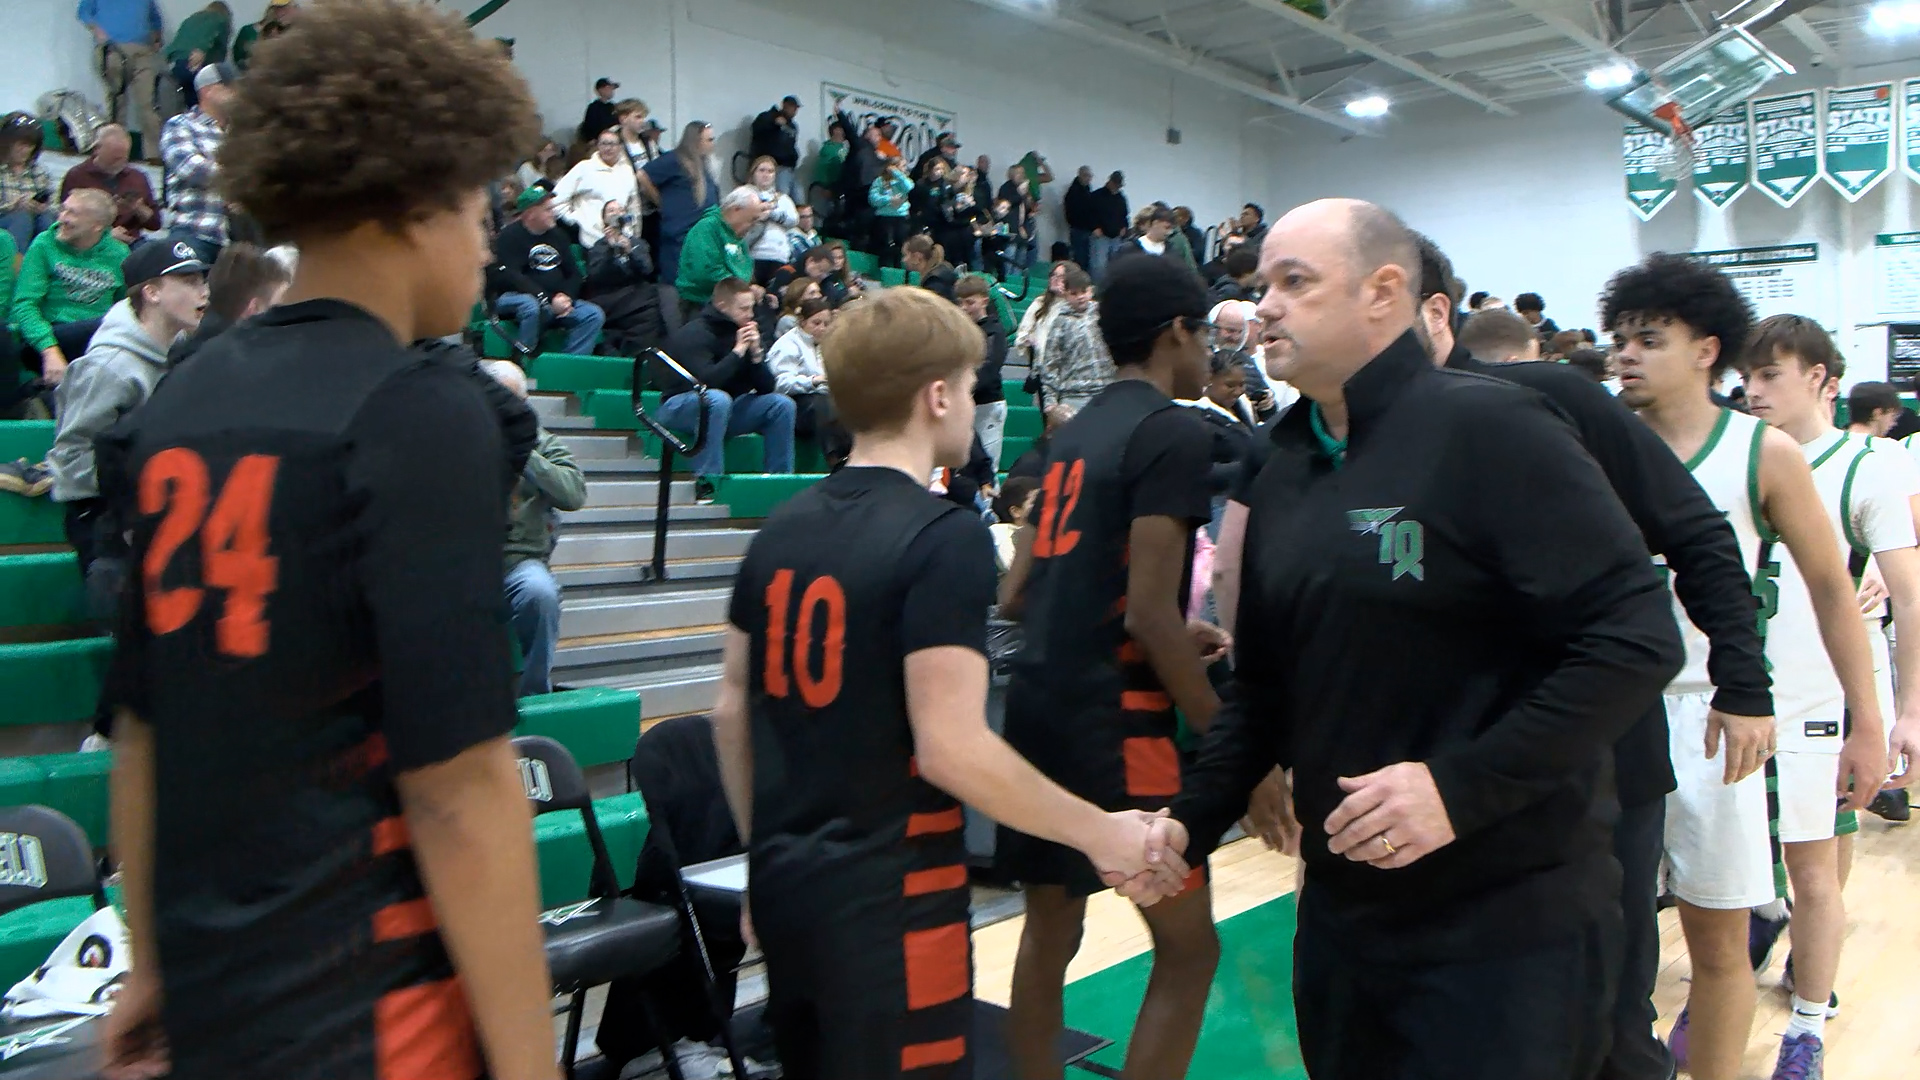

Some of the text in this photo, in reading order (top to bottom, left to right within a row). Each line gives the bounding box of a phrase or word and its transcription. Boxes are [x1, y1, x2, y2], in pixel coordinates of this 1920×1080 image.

[138, 446, 281, 658] 24
[1031, 458, 1086, 558] 12
[1378, 520, 1424, 581] 10
[764, 568, 846, 708] 10
